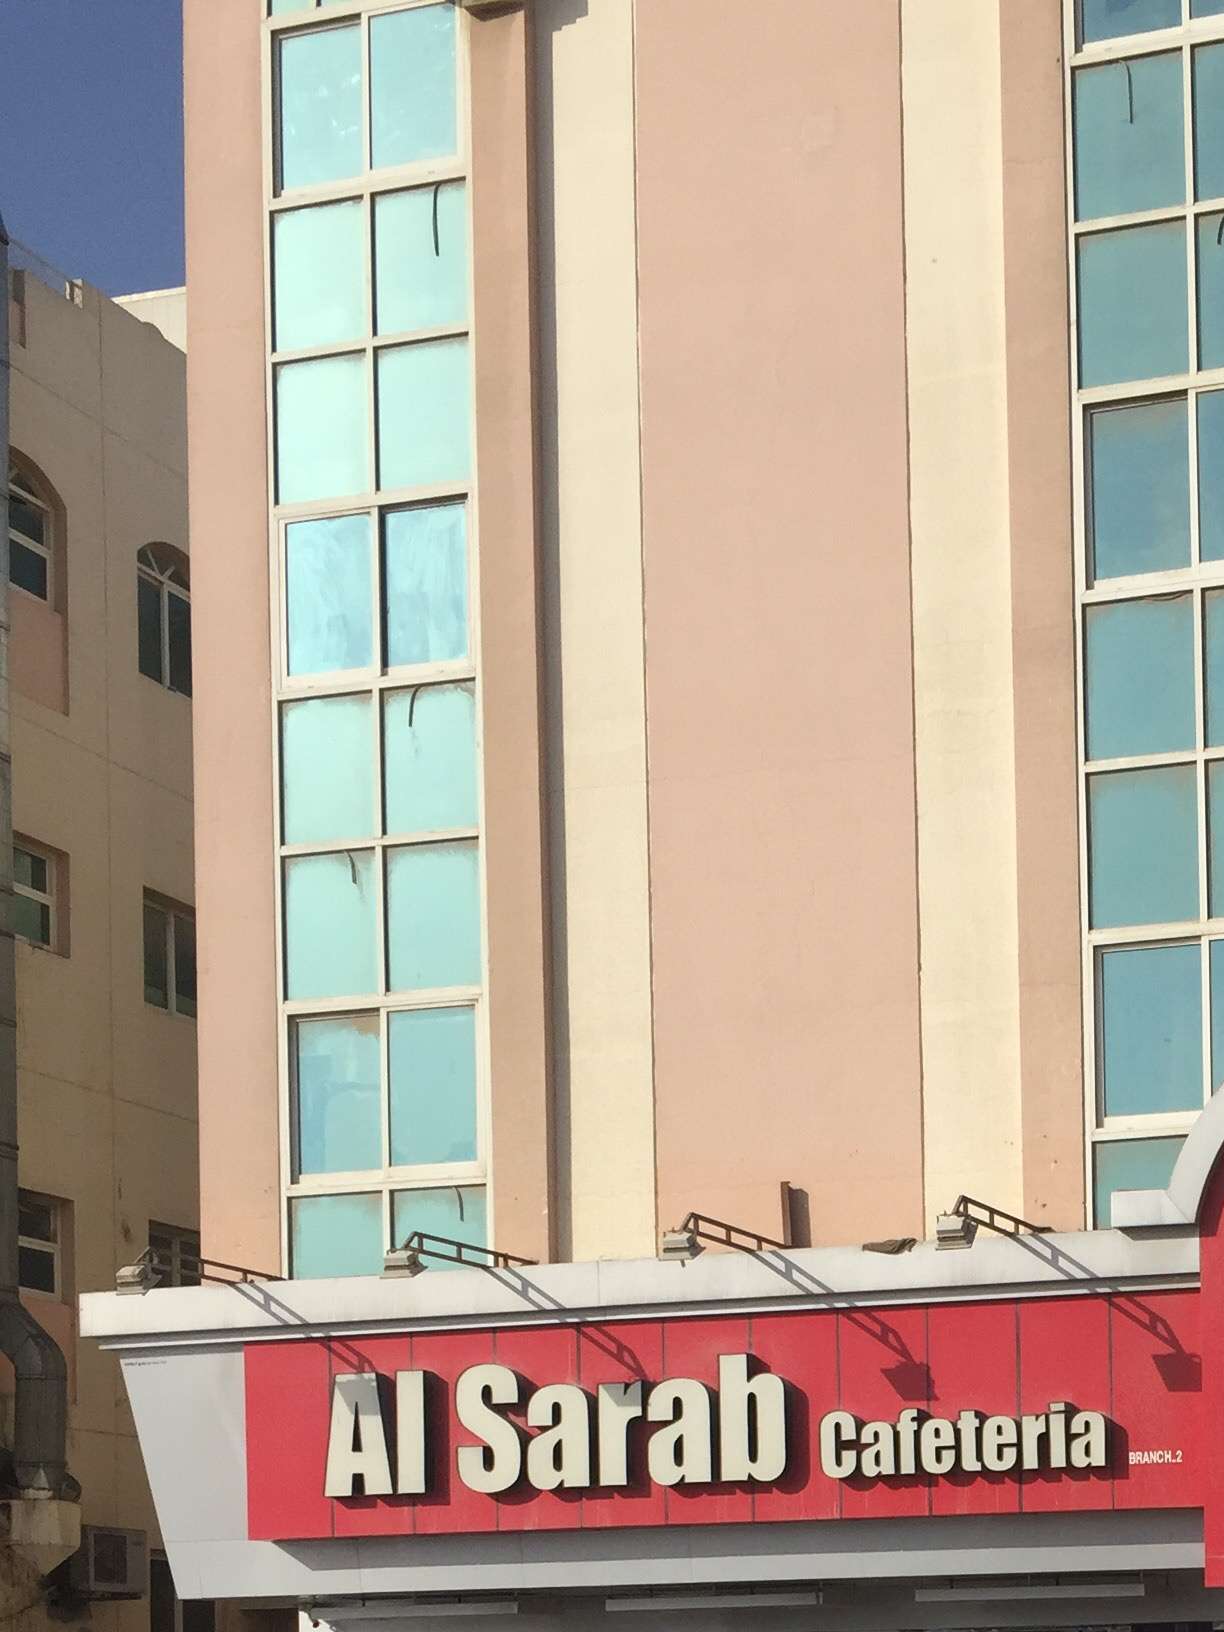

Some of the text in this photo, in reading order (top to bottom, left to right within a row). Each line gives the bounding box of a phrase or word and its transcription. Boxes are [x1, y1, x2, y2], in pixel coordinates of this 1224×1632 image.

[325, 1353, 1106, 1498] Al Sarab Cafeteria
